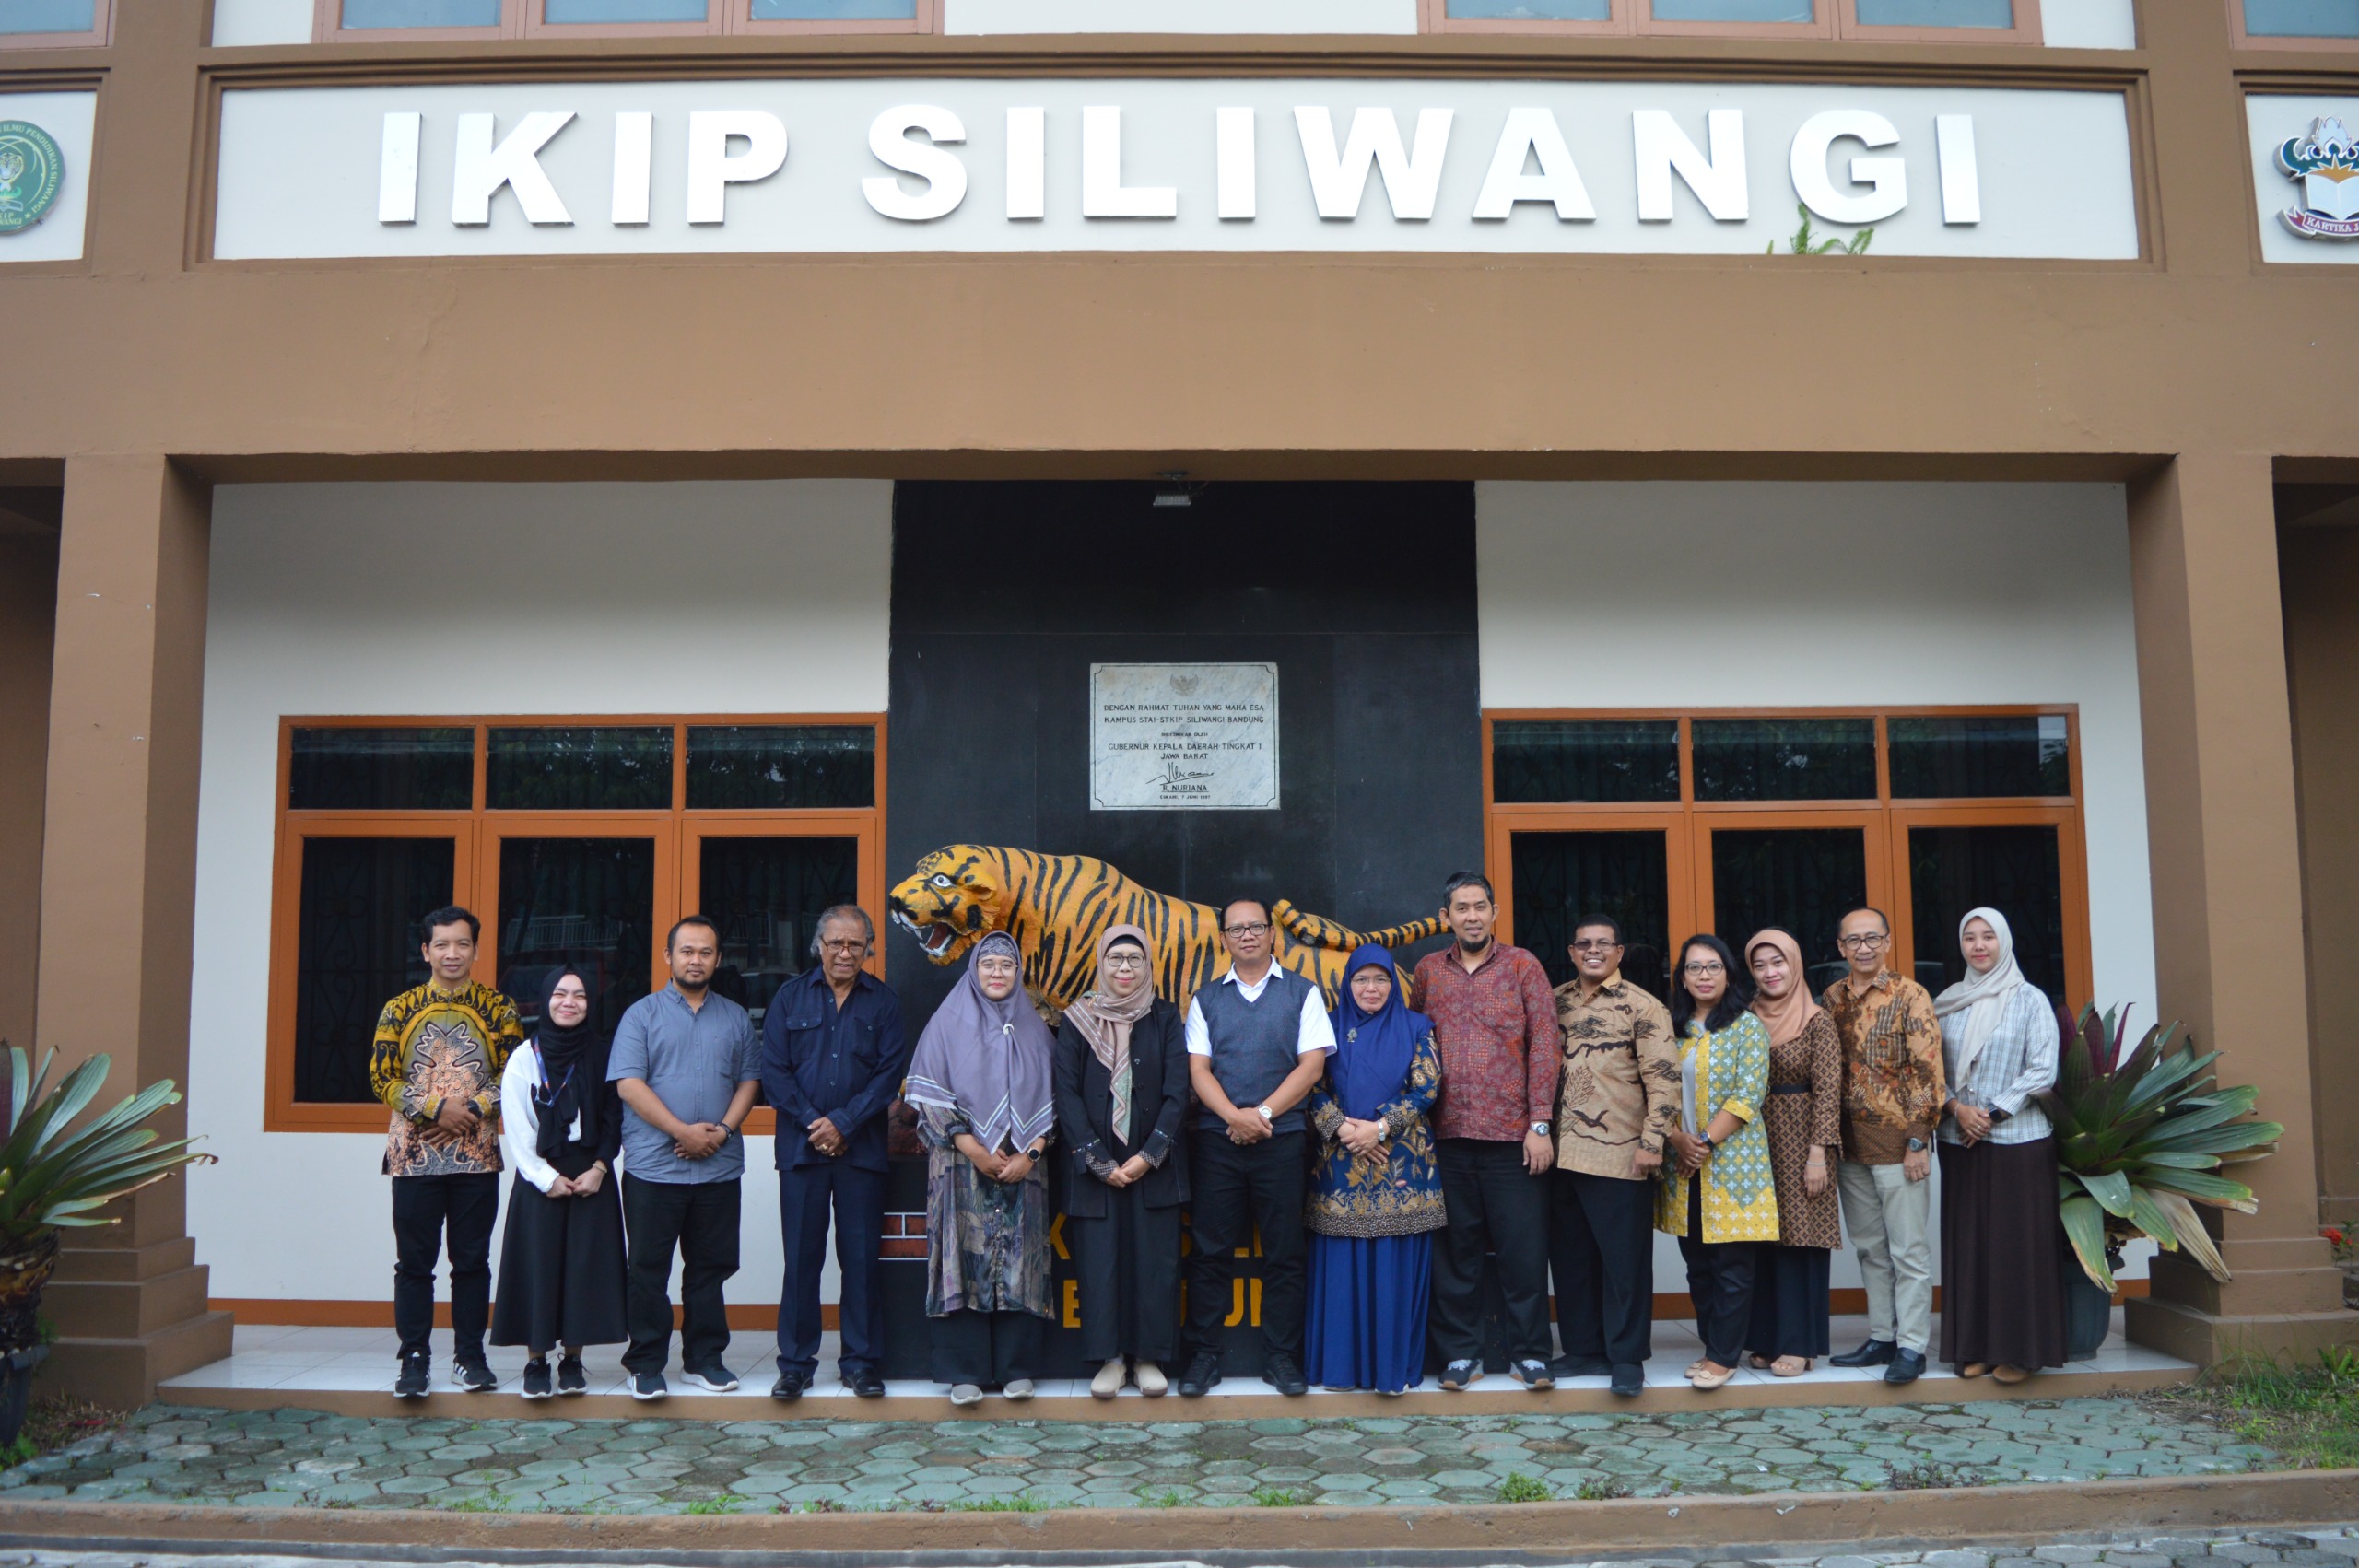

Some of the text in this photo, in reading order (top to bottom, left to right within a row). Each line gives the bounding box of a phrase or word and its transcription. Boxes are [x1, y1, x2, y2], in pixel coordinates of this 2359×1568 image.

[378, 104, 1982, 227] IKIP SILIWANGI
[2306, 217, 2352, 232] KARTIKA
